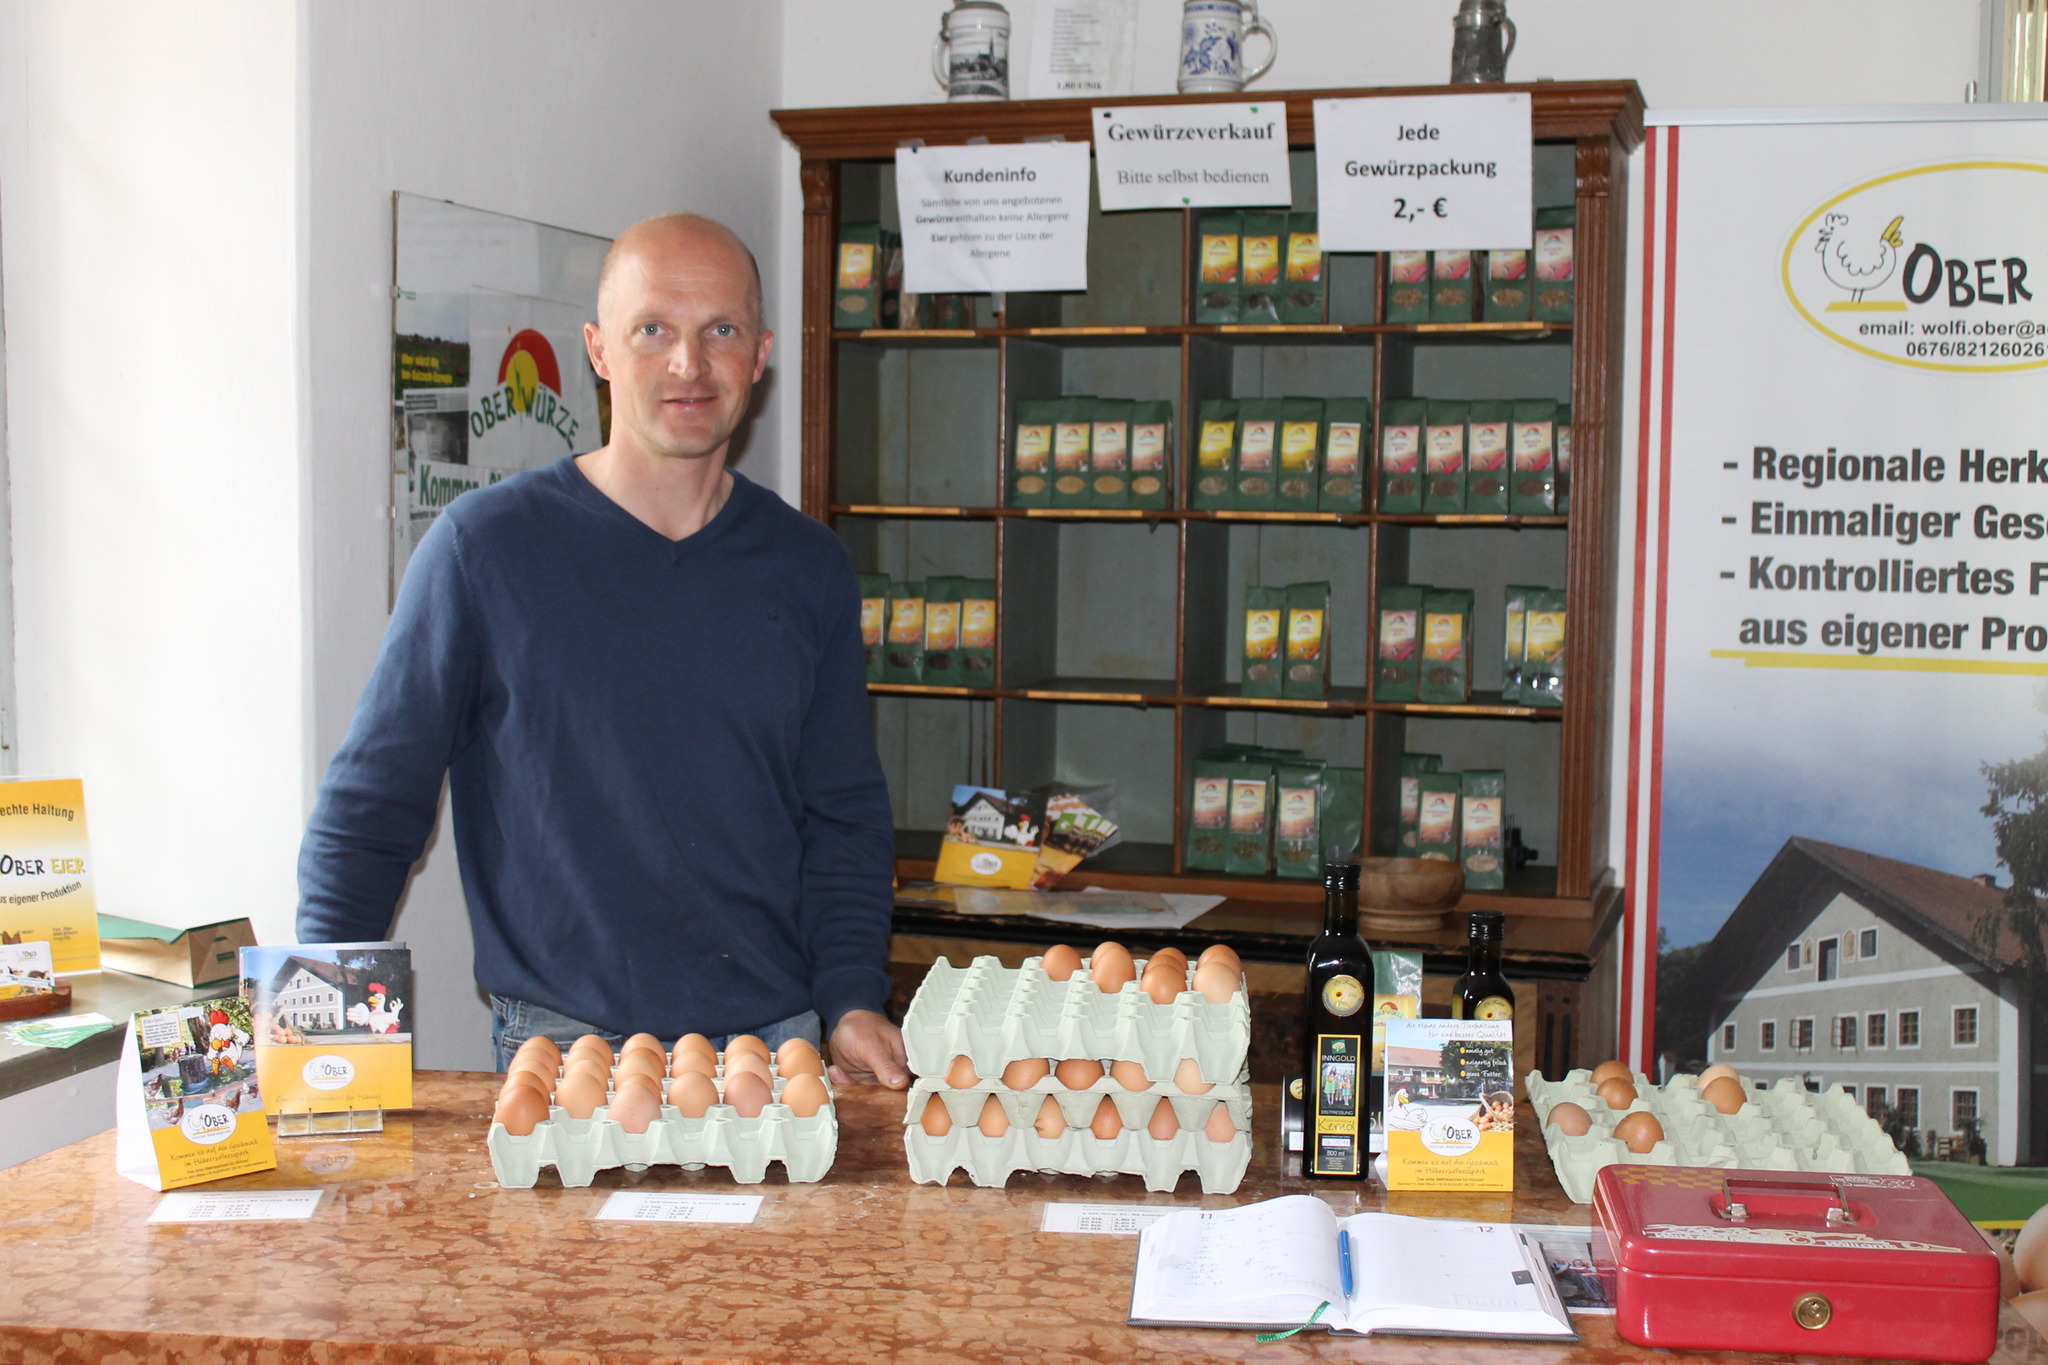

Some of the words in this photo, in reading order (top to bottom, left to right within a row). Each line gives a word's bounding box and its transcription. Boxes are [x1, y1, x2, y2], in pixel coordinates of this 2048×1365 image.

[1108, 122, 1275, 141] Gewürzeverkauf
[1397, 124, 1440, 141] Jede
[944, 167, 1037, 183] Kundeninfo
[1117, 170, 1152, 184] Bitte
[1158, 169, 1198, 184] selbst
[1204, 169, 1269, 184] bedienen
[1345, 159, 1497, 180] Gewürzpackung
[1001, 196, 1062, 207] angebotenen
[1433, 198, 1448, 218] €
[916, 214, 953, 224] Gewürze
[955, 213, 997, 223] enthalten
[999, 213, 1024, 222] keine
[1026, 212, 1069, 223] Allergene
[931, 233, 947, 242] Eier
[949, 232, 982, 243] gehören
[997, 232, 1012, 241] der
[1015, 232, 1035, 241] Liste
[1039, 231, 1054, 240] der
[970, 249, 1011, 259] Allergene
[1902, 242, 2033, 308] OBER
[1859, 320, 1914, 335] email:
[1922, 320, 2048, 339] wolfi.ober@a
[1752, 446, 1945, 489] Regionale
[1959, 448, 2048, 483] Herk
[1751, 501, 1961, 545] Einmaliger
[1974, 504, 2048, 539] Ges
[1749, 556, 2015, 595] Kontrolliertes
[1739, 617, 1807, 645] aus
[1821, 613, 1969, 655] eigener
[1981, 616, 2048, 651] Pro
[32, 803, 74, 821] Haltung
[0, 854, 45, 876] OBER
[50, 857, 86, 874] EIER
[9, 894, 39, 905] eigener
[40, 881, 82, 901] Produktion
[324, 1064, 348, 1077] OBER
[204, 1114, 230, 1127] OBER
[1319, 1118, 1355, 1131] Kernöl
[1447, 1126, 1473, 1140] OBER
